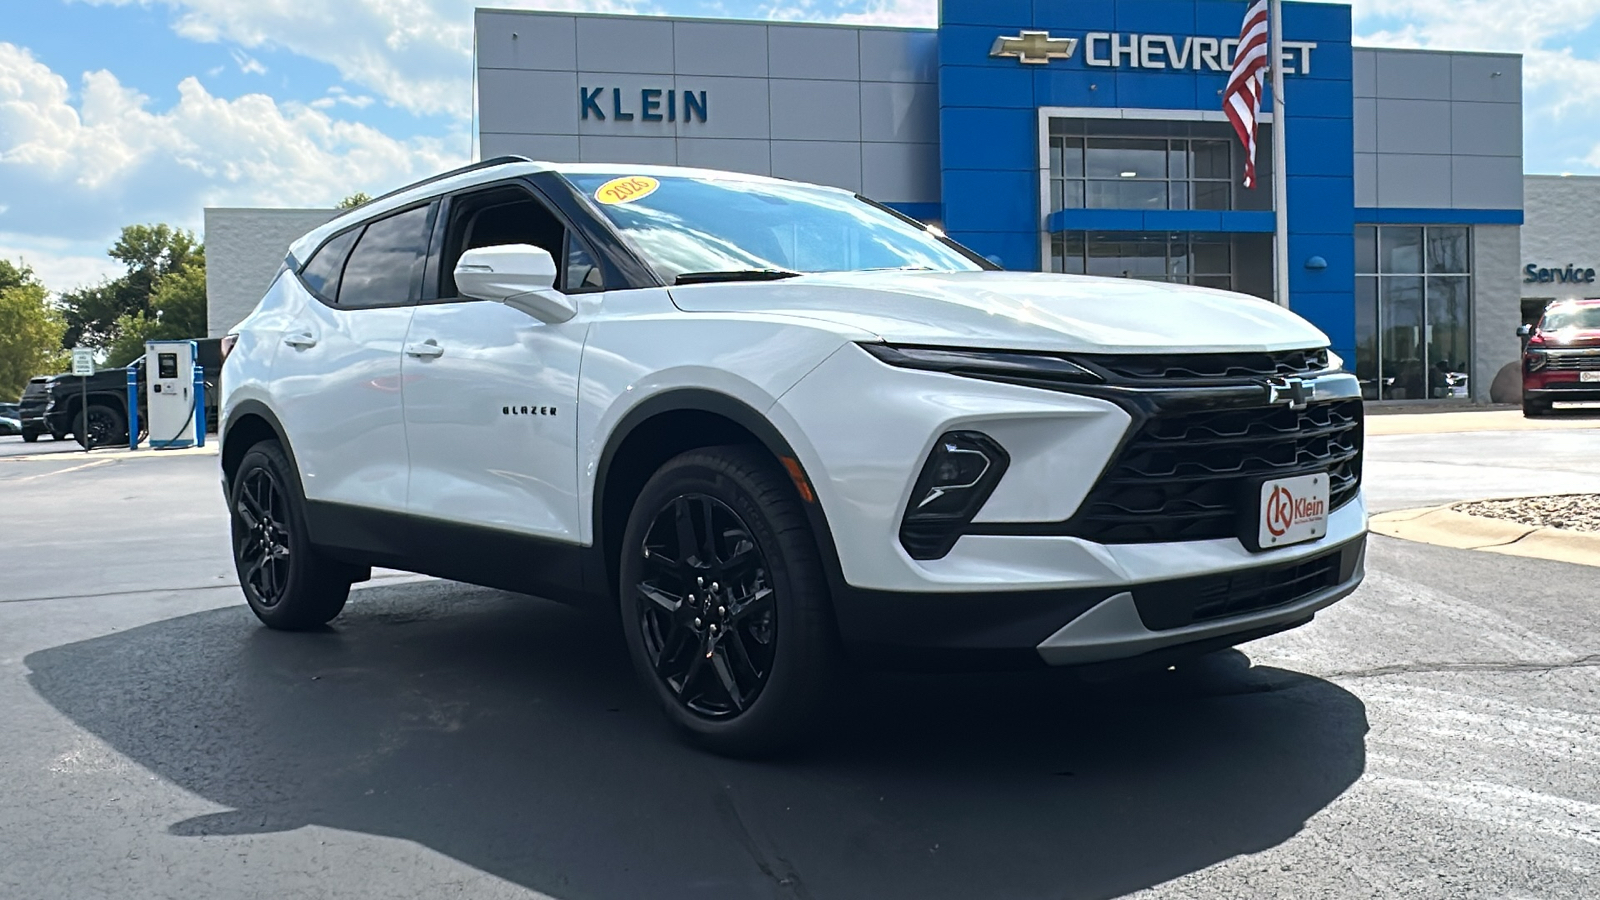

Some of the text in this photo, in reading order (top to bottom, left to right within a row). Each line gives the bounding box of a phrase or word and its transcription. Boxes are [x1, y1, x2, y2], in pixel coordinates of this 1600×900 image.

[1085, 31, 1317, 75] CHEVROET
[580, 86, 708, 123] KLEIN
[605, 177, 650, 201] 2026
[1524, 263, 1596, 284] Service
[502, 405, 557, 417] BLAZER
[1294, 495, 1324, 520] Klein
